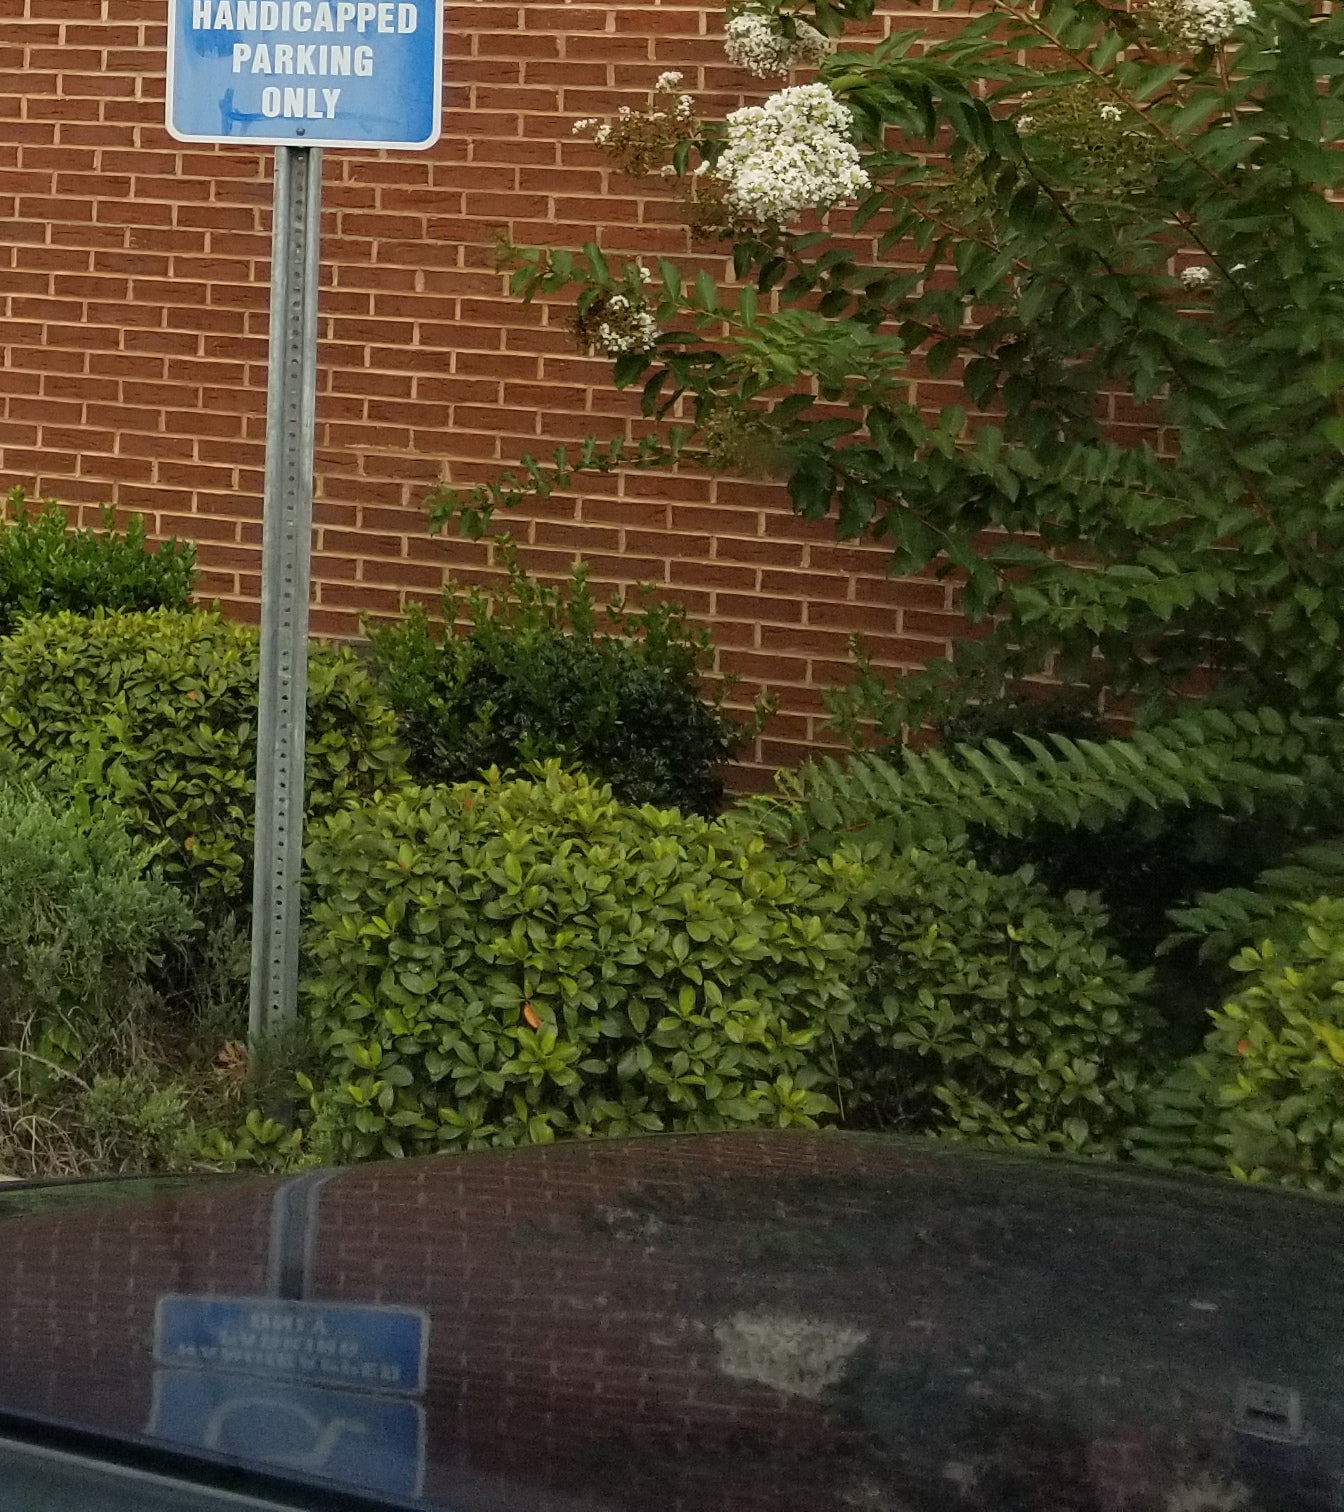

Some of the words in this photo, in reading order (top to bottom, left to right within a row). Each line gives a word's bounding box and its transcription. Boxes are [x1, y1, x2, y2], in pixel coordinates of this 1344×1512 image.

[192, 0, 418, 34] HANDICAPPED
[232, 43, 374, 77] PARKING
[262, 86, 341, 120] ONLY
